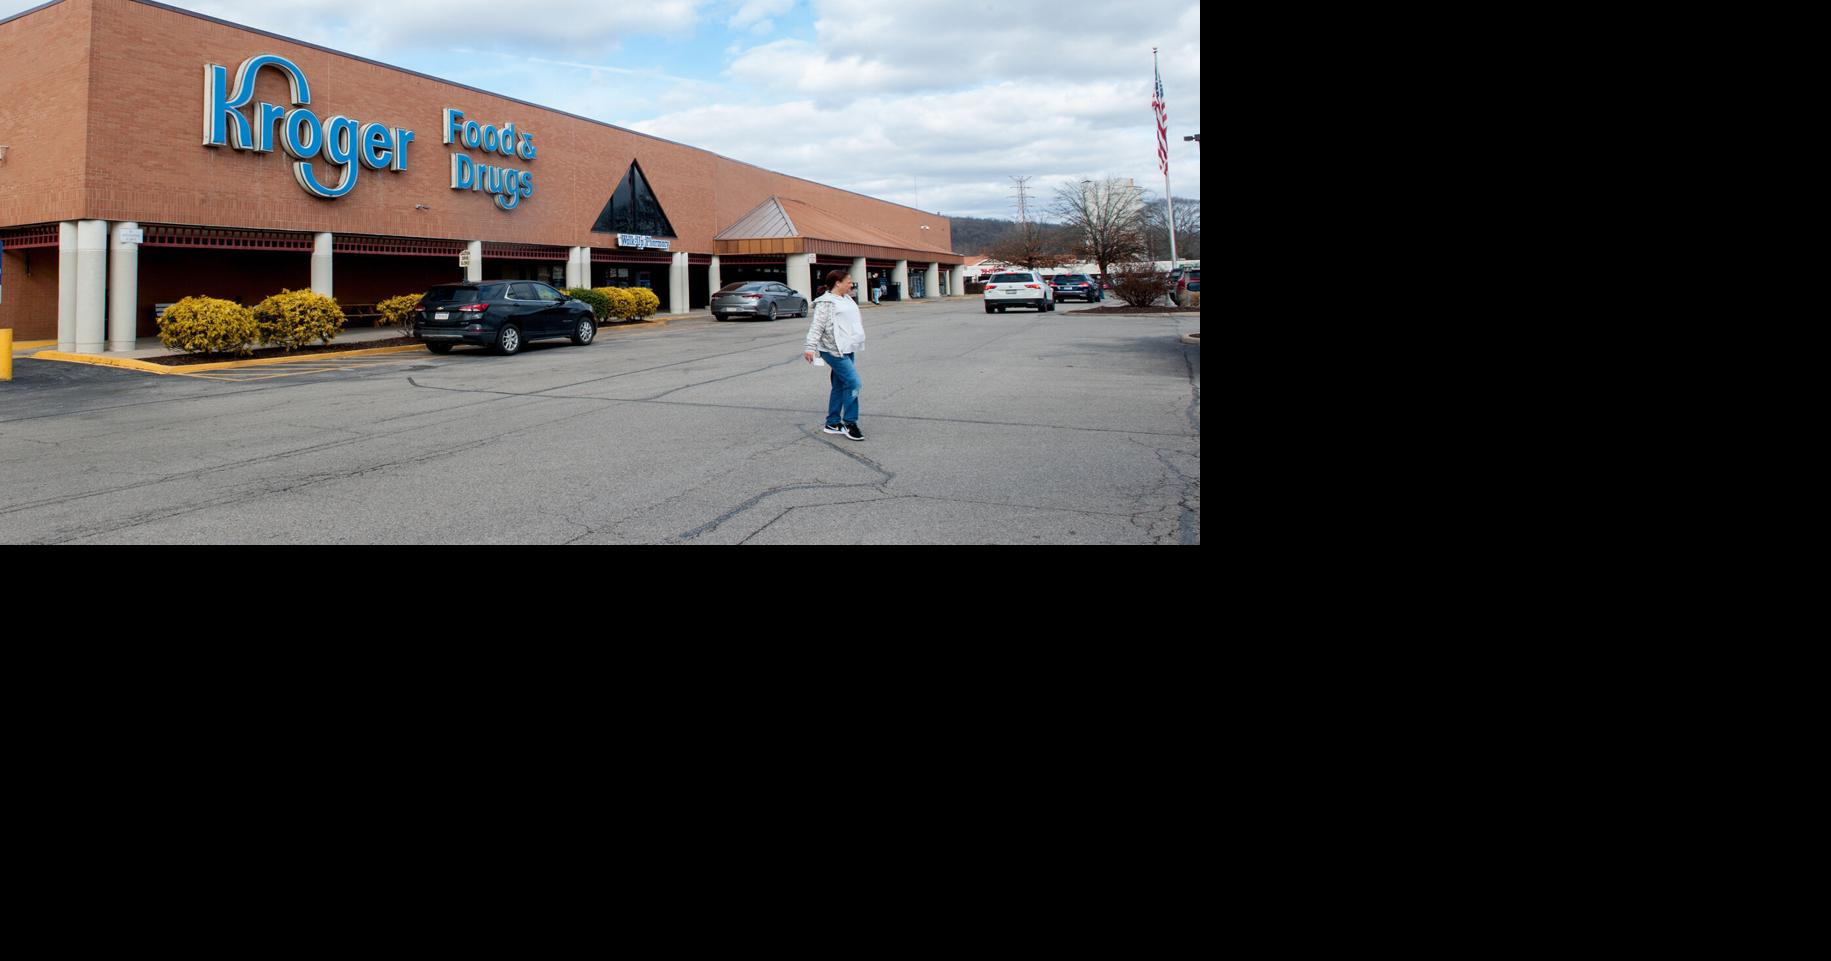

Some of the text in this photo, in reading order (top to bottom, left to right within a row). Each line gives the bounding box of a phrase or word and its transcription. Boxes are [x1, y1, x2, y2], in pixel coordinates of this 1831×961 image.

[203, 55, 415, 197] Kroger
[443, 108, 537, 160] Food &
[451, 153, 533, 209] Drugs
